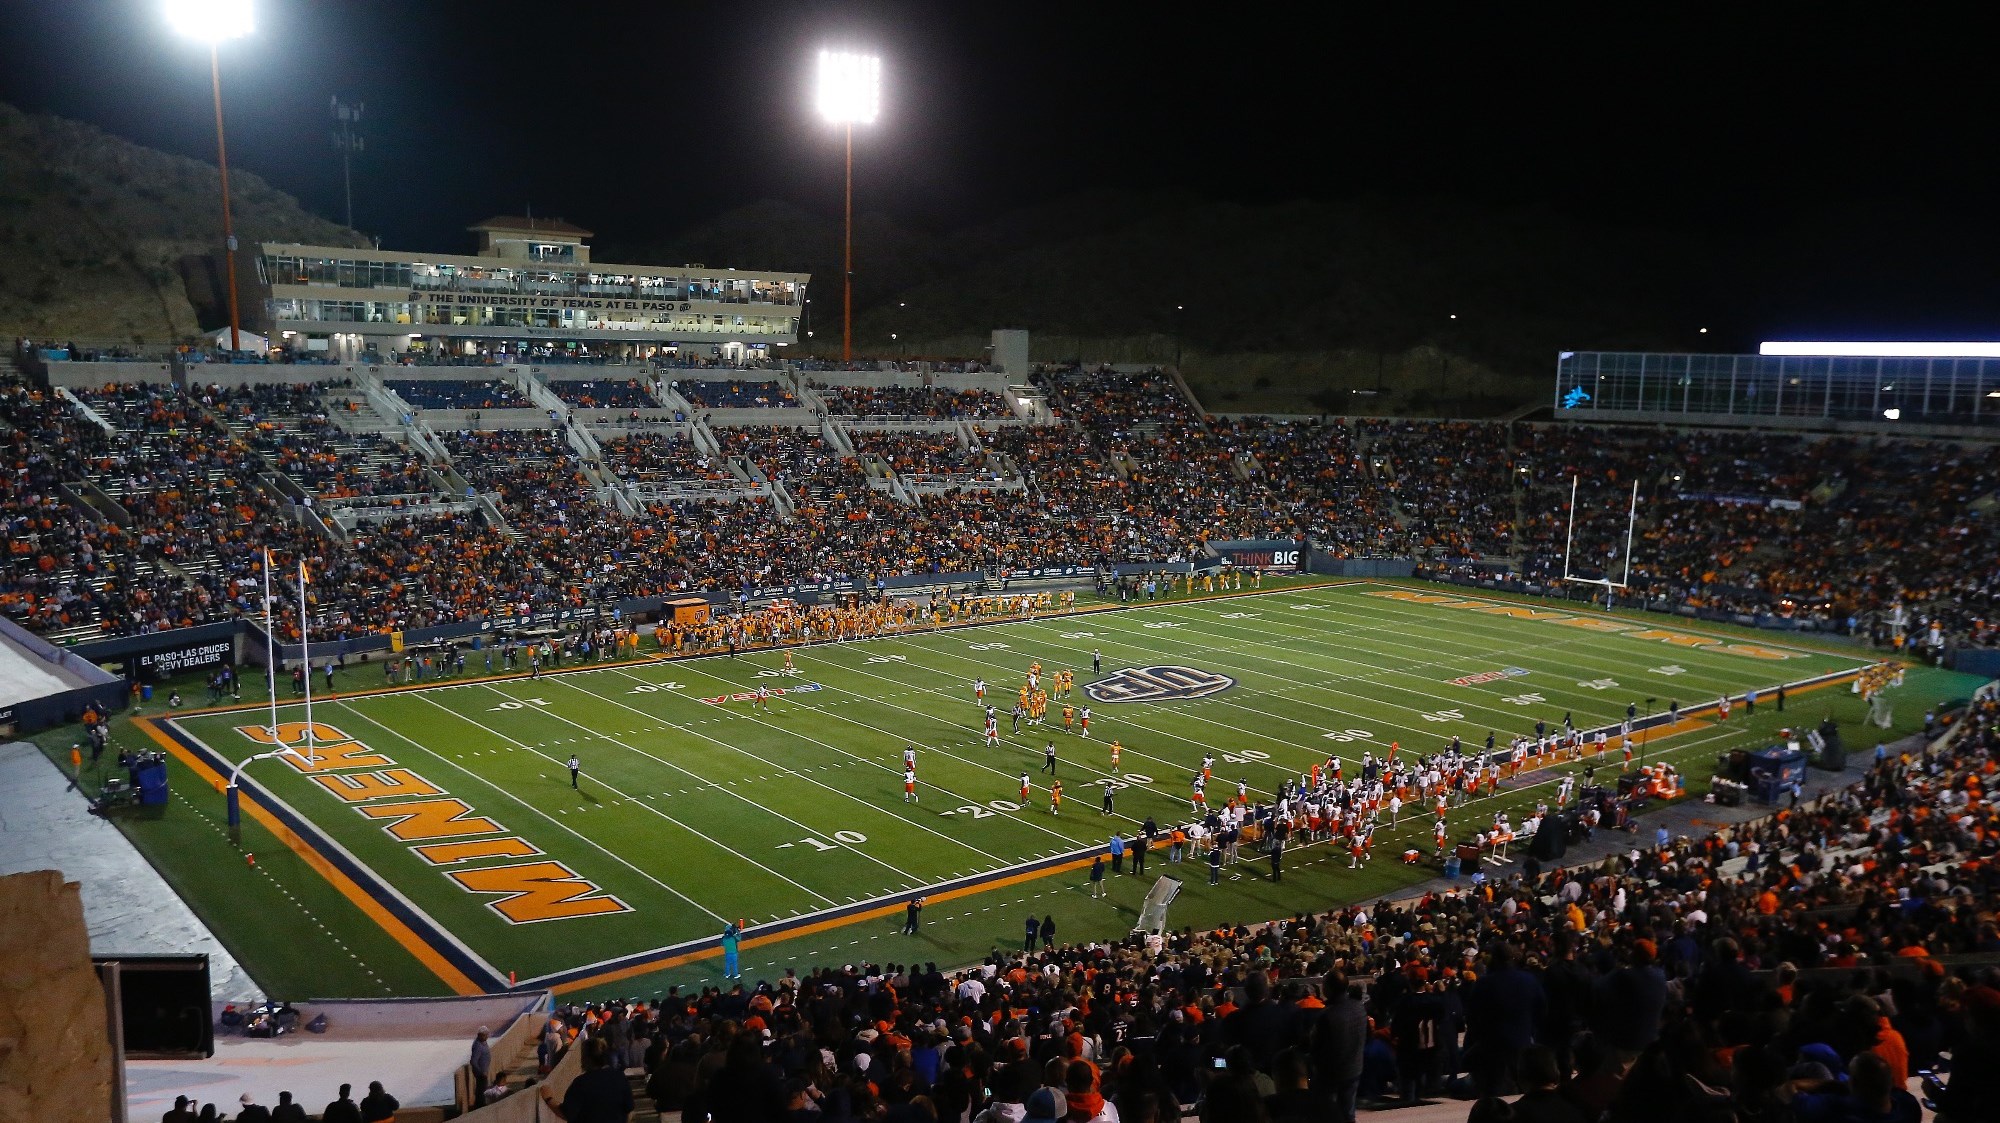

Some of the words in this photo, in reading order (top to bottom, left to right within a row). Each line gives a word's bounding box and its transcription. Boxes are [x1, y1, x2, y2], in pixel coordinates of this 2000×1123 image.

[429, 293, 454, 303] THE
[458, 294, 537, 306] UNIVERSITY
[541, 299, 560, 307] OF
[562, 299, 602, 309] TEXAS
[606, 301, 621, 309] AT
[624, 301, 639, 310] EL
[643, 302, 675, 311] PASO
[142, 655, 153, 666] EL
[154, 648, 197, 662] PASO-LAS
[198, 642, 230, 656] CRUCES
[183, 653, 221, 667] DEALERS
[1321, 729, 1374, 742] 50
[1221, 750, 1271, 764] 40
[956, 800, 1021, 819] 20
[233, 721, 637, 926] MINERS
[798, 830, 868, 852] 10
